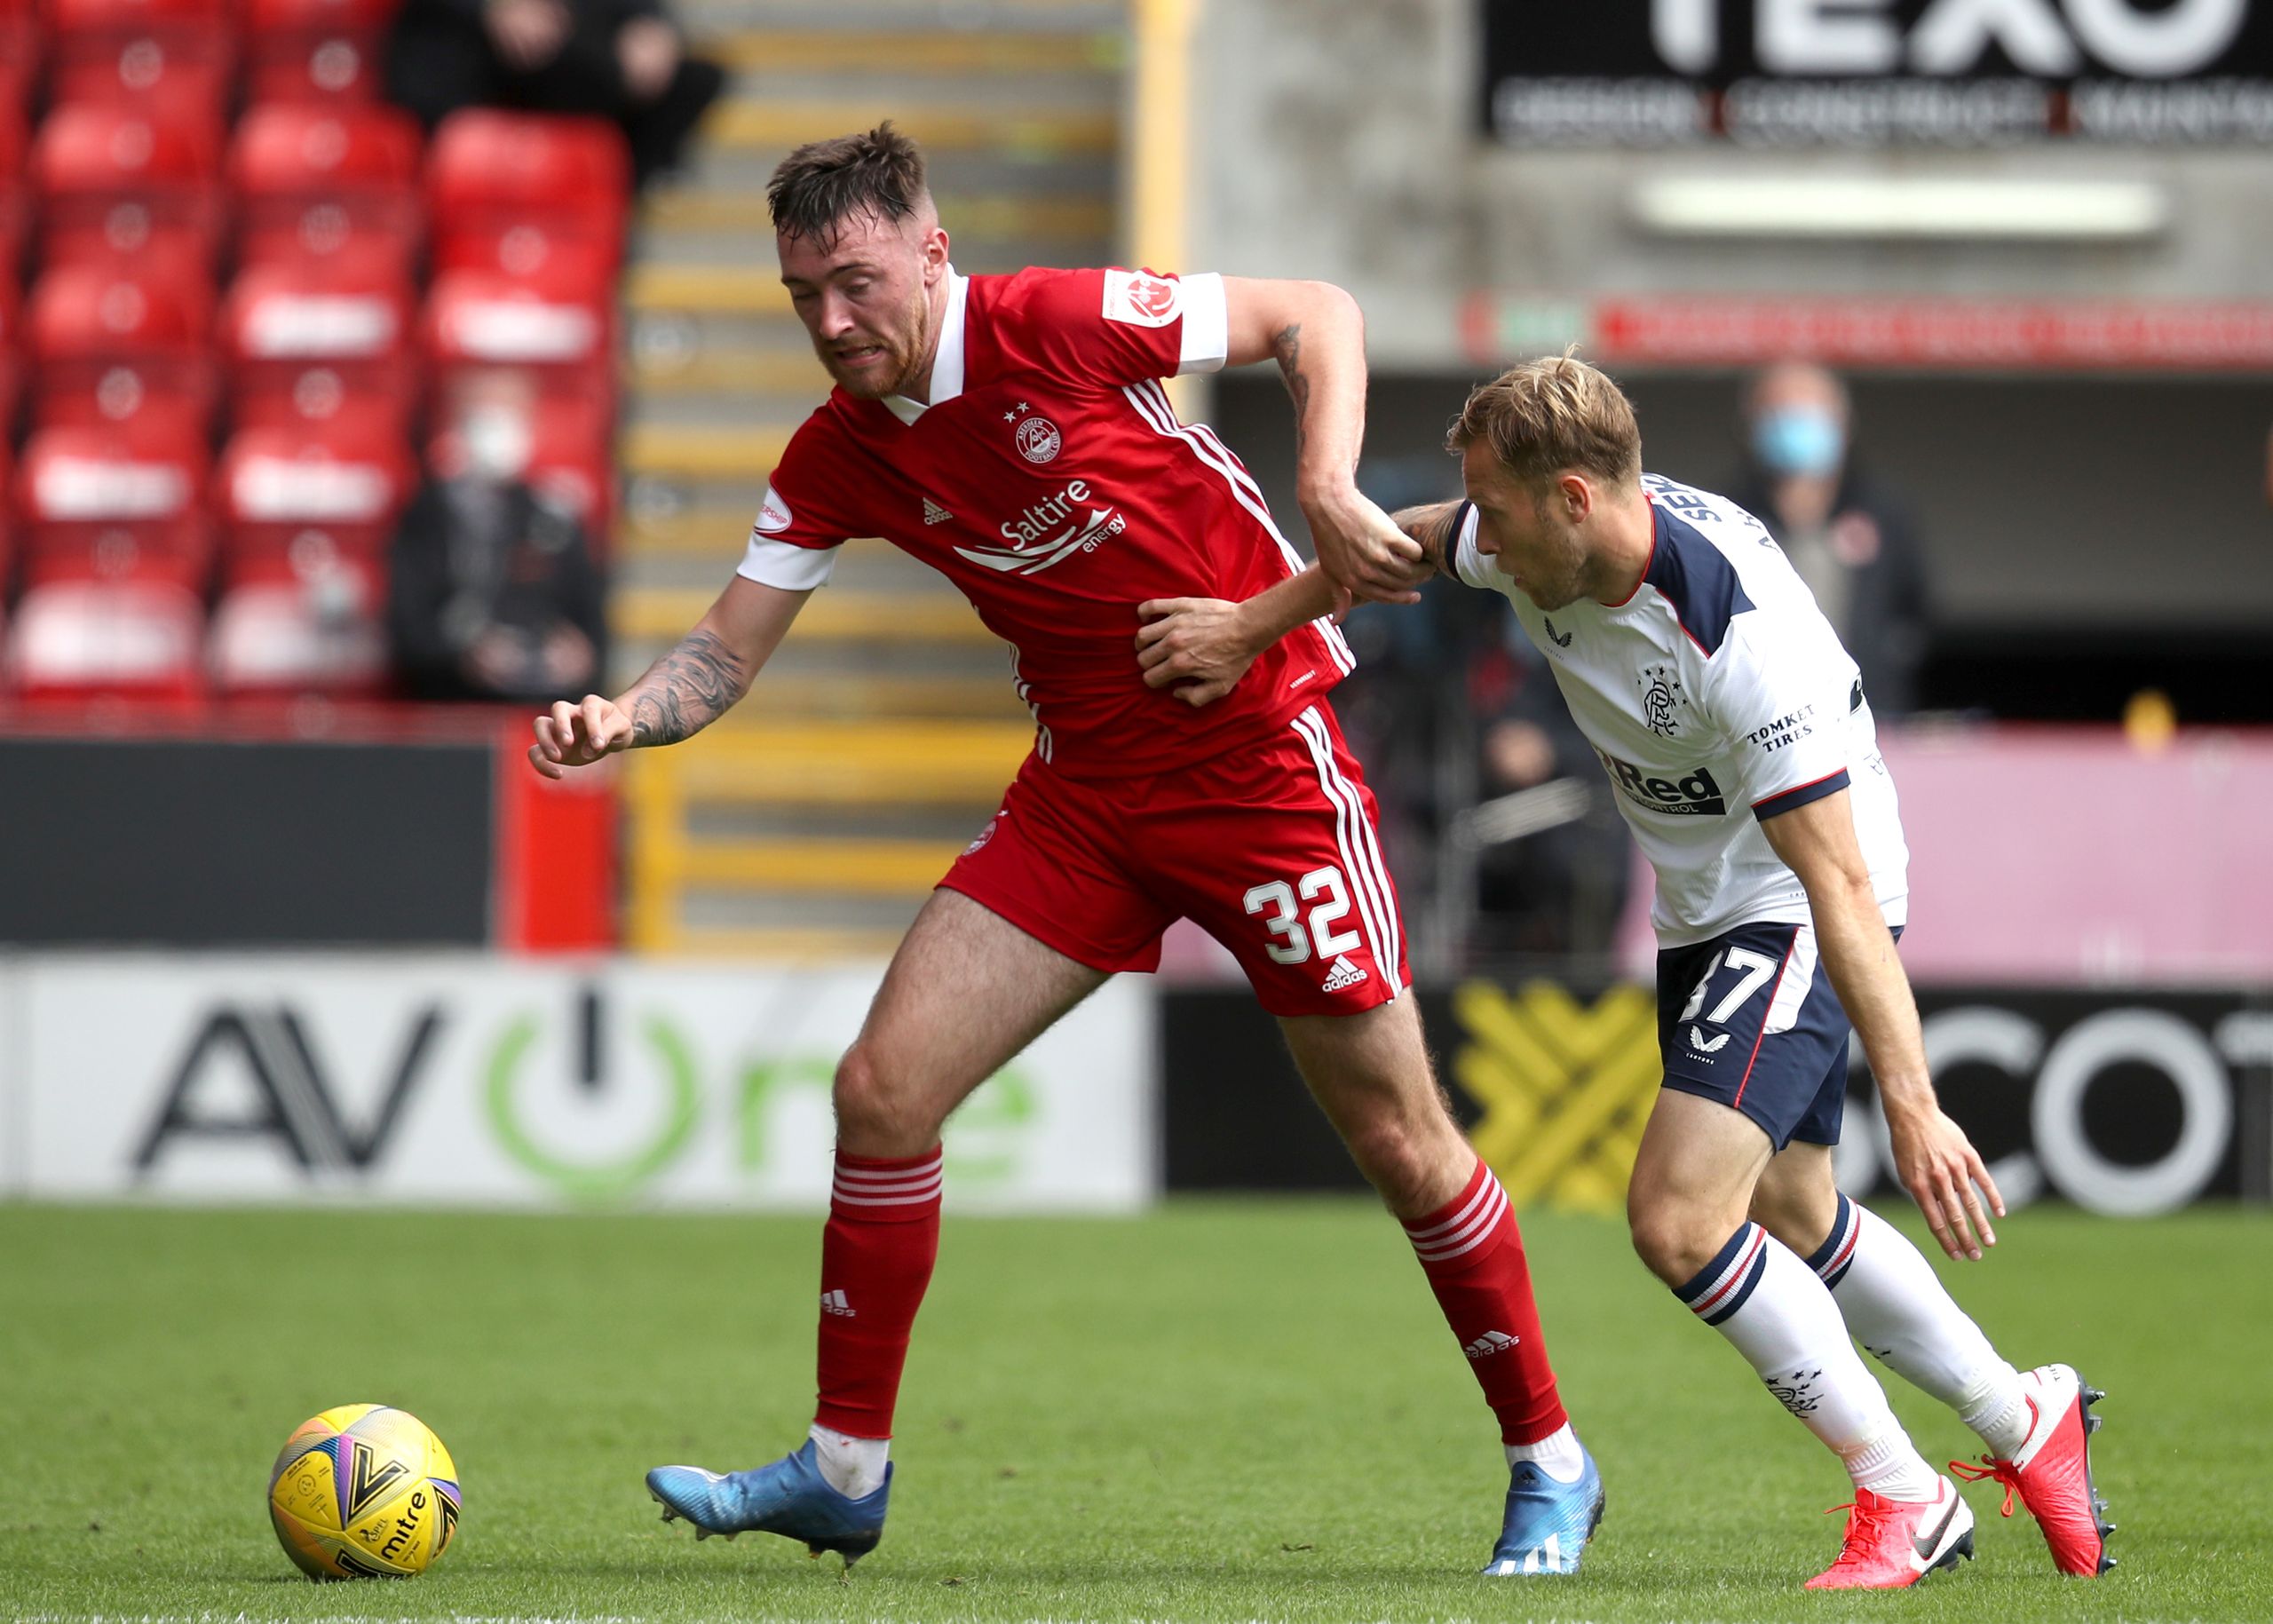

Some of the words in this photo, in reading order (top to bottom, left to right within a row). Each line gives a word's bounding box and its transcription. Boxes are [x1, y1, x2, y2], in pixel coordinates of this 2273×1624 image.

[760, 504, 788, 524] ERSHIP
[1001, 480, 1091, 551] Saltire
[1082, 512, 1128, 553] energy
[1747, 704, 1815, 745] TOMKET
[1762, 725, 1812, 753] TIRES
[1604, 755, 1722, 802] Red
[1243, 865, 1361, 965] 32
[1322, 969, 1367, 993] adidas
[381, 1493, 426, 1561] mitre
